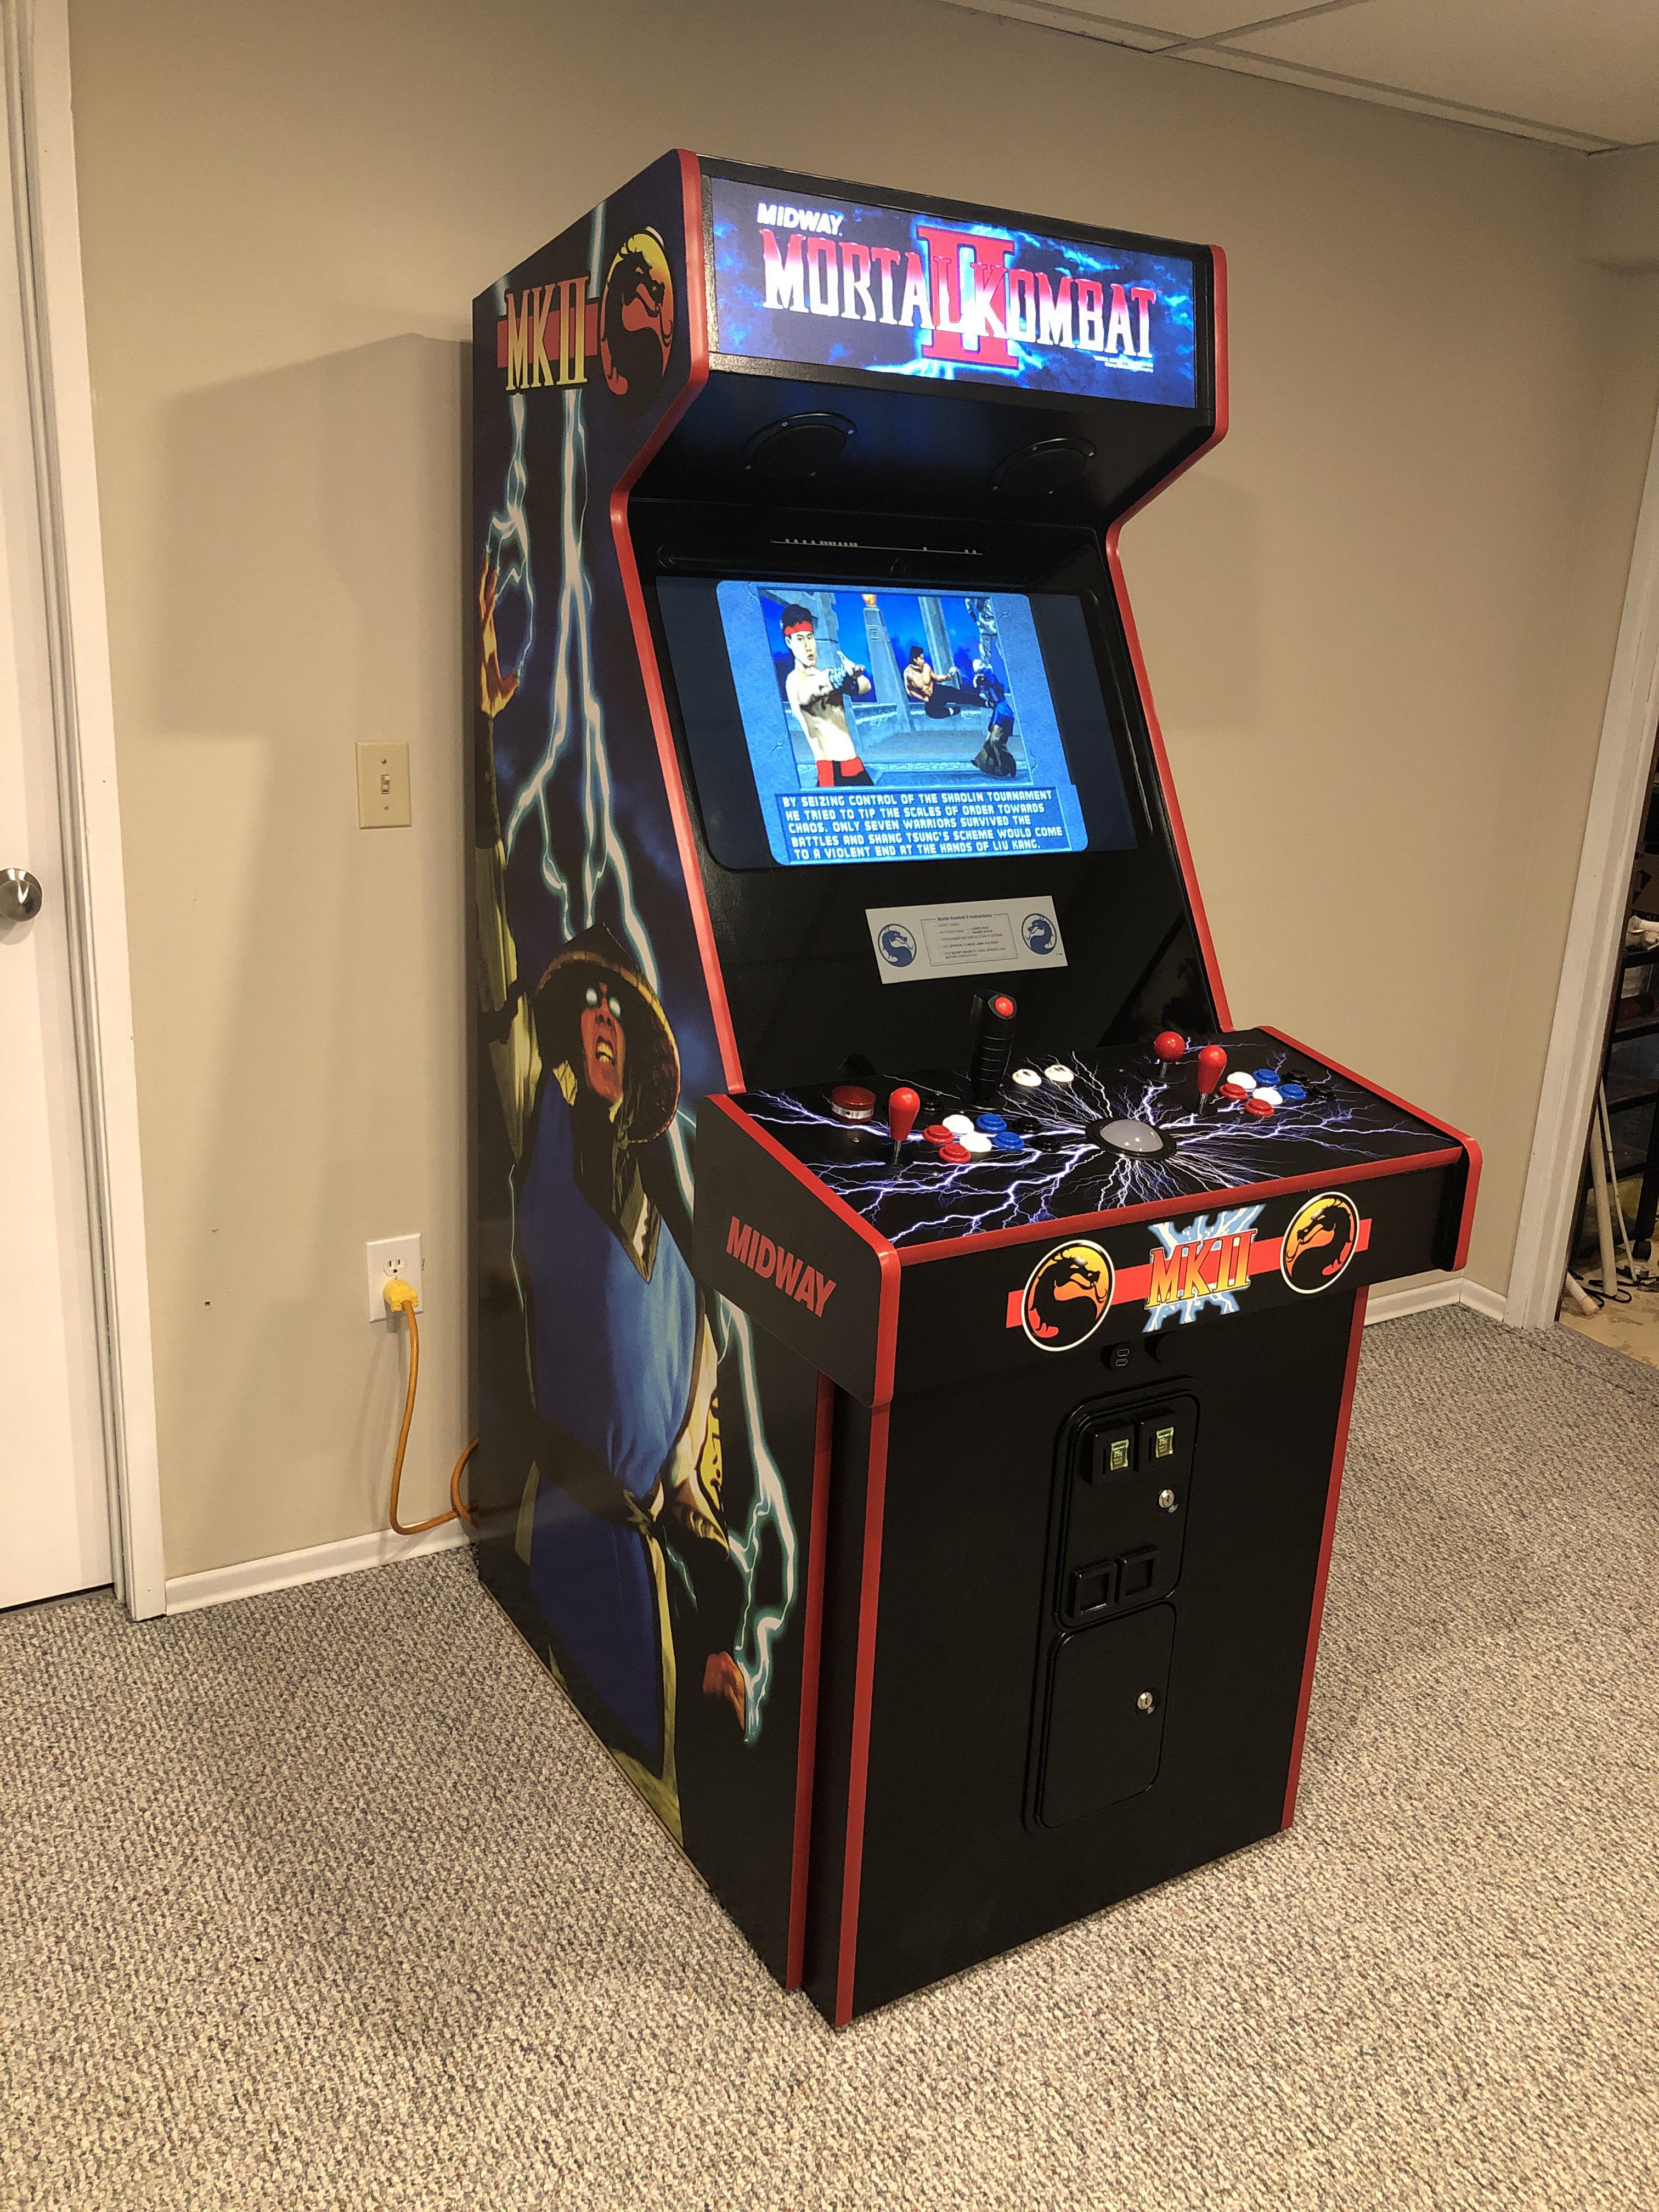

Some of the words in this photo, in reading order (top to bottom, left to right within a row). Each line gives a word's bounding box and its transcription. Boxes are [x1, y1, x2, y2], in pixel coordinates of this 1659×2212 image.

[759, 228, 966, 334] MORTAL
[969, 261, 1156, 358] KOMBAT
[782, 797, 797, 808] BY
[800, 795, 845, 807] SEIZING
[848, 794, 898, 806] CONTROL
[900, 794, 915, 804] OF
[918, 793, 938, 804] THE
[941, 792, 984, 803] SHAOLIN
[986, 790, 1053, 802] TOURNAMENT
[785, 810, 800, 821] HE
[804, 809, 837, 821] TRIED
[839, 809, 855, 820] TO
[857, 808, 877, 819] TIP
[879, 807, 900, 818] THE
[903, 806, 942, 817] SCALES
[944, 806, 959, 816] OF
[962, 804, 995, 815] ORDER
[997, 803, 1045, 815] TOWARDS
[788, 822, 828, 834] CHAOS.
[832, 821, 861, 832] ONLY
[864, 820, 900, 831] SEVEN
[902, 817, 957, 830] WARRIORS
[960, 816, 1010, 827] SURVIVED
[1012, 815, 1031, 825] THE
[791, 835, 840, 848] BATTLES
[843, 834, 865, 846] AND
[868, 833, 903, 844] SHANG
[905, 831, 950, 843] TSUNG'S
[952, 829, 994, 841] SCHEME
[996, 827, 1032, 839] WOULD
[1034, 826, 1063, 838] COME
[794, 849, 810, 860] TO
[813, 848, 821, 859] A
[824, 847, 872, 859] VIOLENT
[874, 845, 896, 857] END
[899, 844, 913, 855] AT
[916, 843, 937, 855] THE
[939, 842, 973, 854] HANDS
[975, 841, 990, 852] OF
[992, 840, 1009, 851] LIU
[1012, 839, 1041, 850] KANG.
[726, 1215, 837, 1318] MIDWAY
[1159, 1437, 1168, 1446] 25¢
[1114, 1449, 1123, 1458] 25¢
